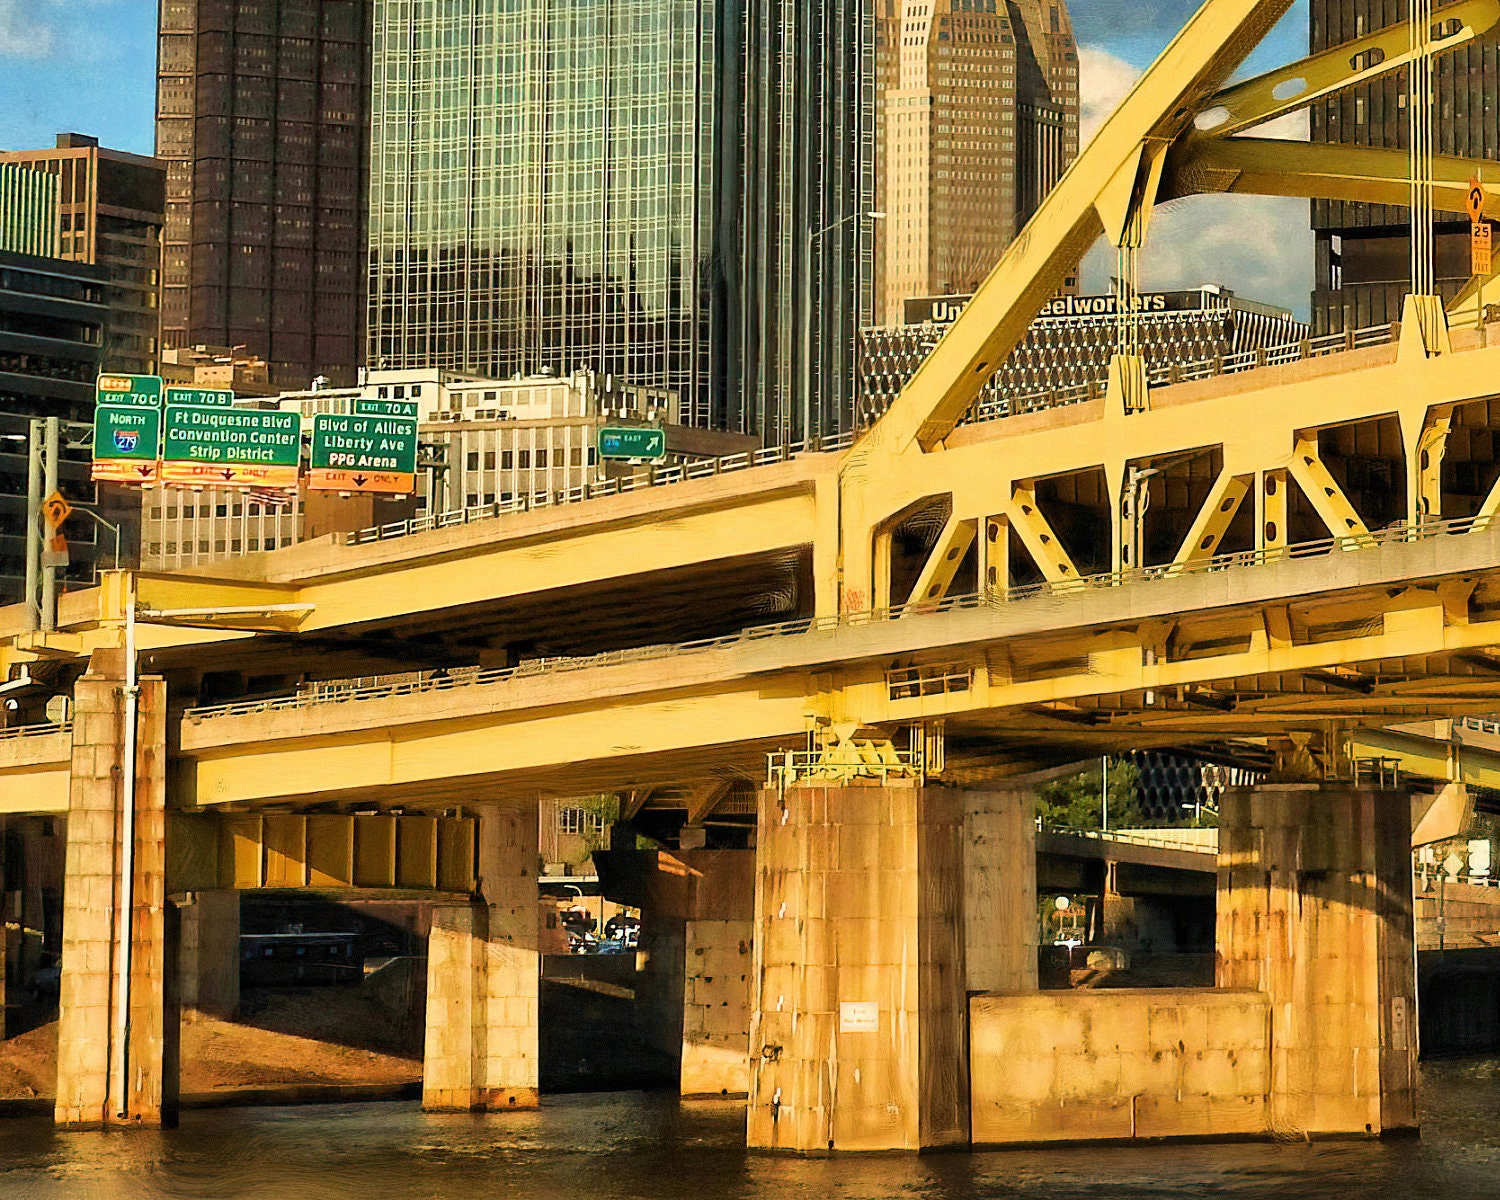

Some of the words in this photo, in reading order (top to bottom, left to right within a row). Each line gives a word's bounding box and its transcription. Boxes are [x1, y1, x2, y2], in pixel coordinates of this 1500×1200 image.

[1474, 226, 1489, 237] 25
[109, 413, 145, 425] NORTH
[175, 412, 188, 424] Ft
[192, 412, 259, 428] Duquesne
[262, 416, 291, 428] Blvd
[319, 419, 348, 432] Blvd
[354, 421, 368, 433] of
[375, 422, 412, 435] Allies
[170, 428, 247, 443] Convention
[250, 432, 295, 445] Center
[324, 435, 373, 451] Liberty
[380, 438, 405, 451] Ave
[190, 446, 220, 460] Strip
[227, 448, 274, 460] District
[329, 453, 355, 466] PPG
[358, 454, 397, 468] Arena
